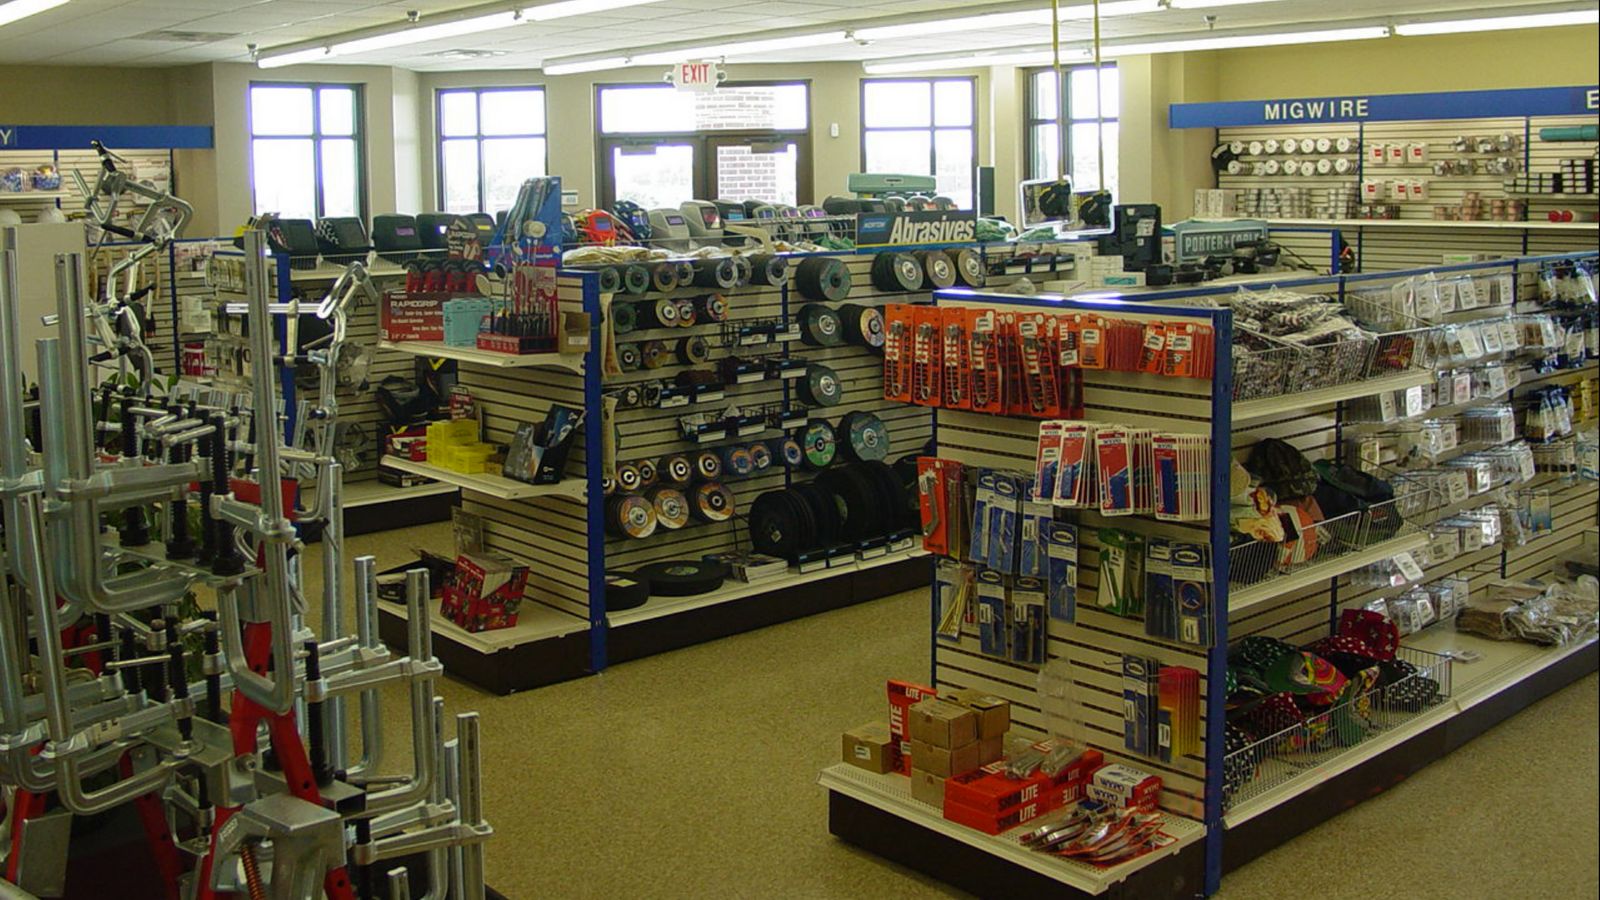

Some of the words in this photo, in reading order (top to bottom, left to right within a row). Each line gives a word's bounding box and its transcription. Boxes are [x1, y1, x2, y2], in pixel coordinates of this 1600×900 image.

[682, 63, 709, 84] EXIT
[1264, 99, 1369, 120] MIGWIRE
[888, 215, 976, 244] Abrasives
[1020, 783, 1040, 804] LITE
[1100, 777, 1125, 792] WYPO
[1018, 802, 1038, 823] LITE
